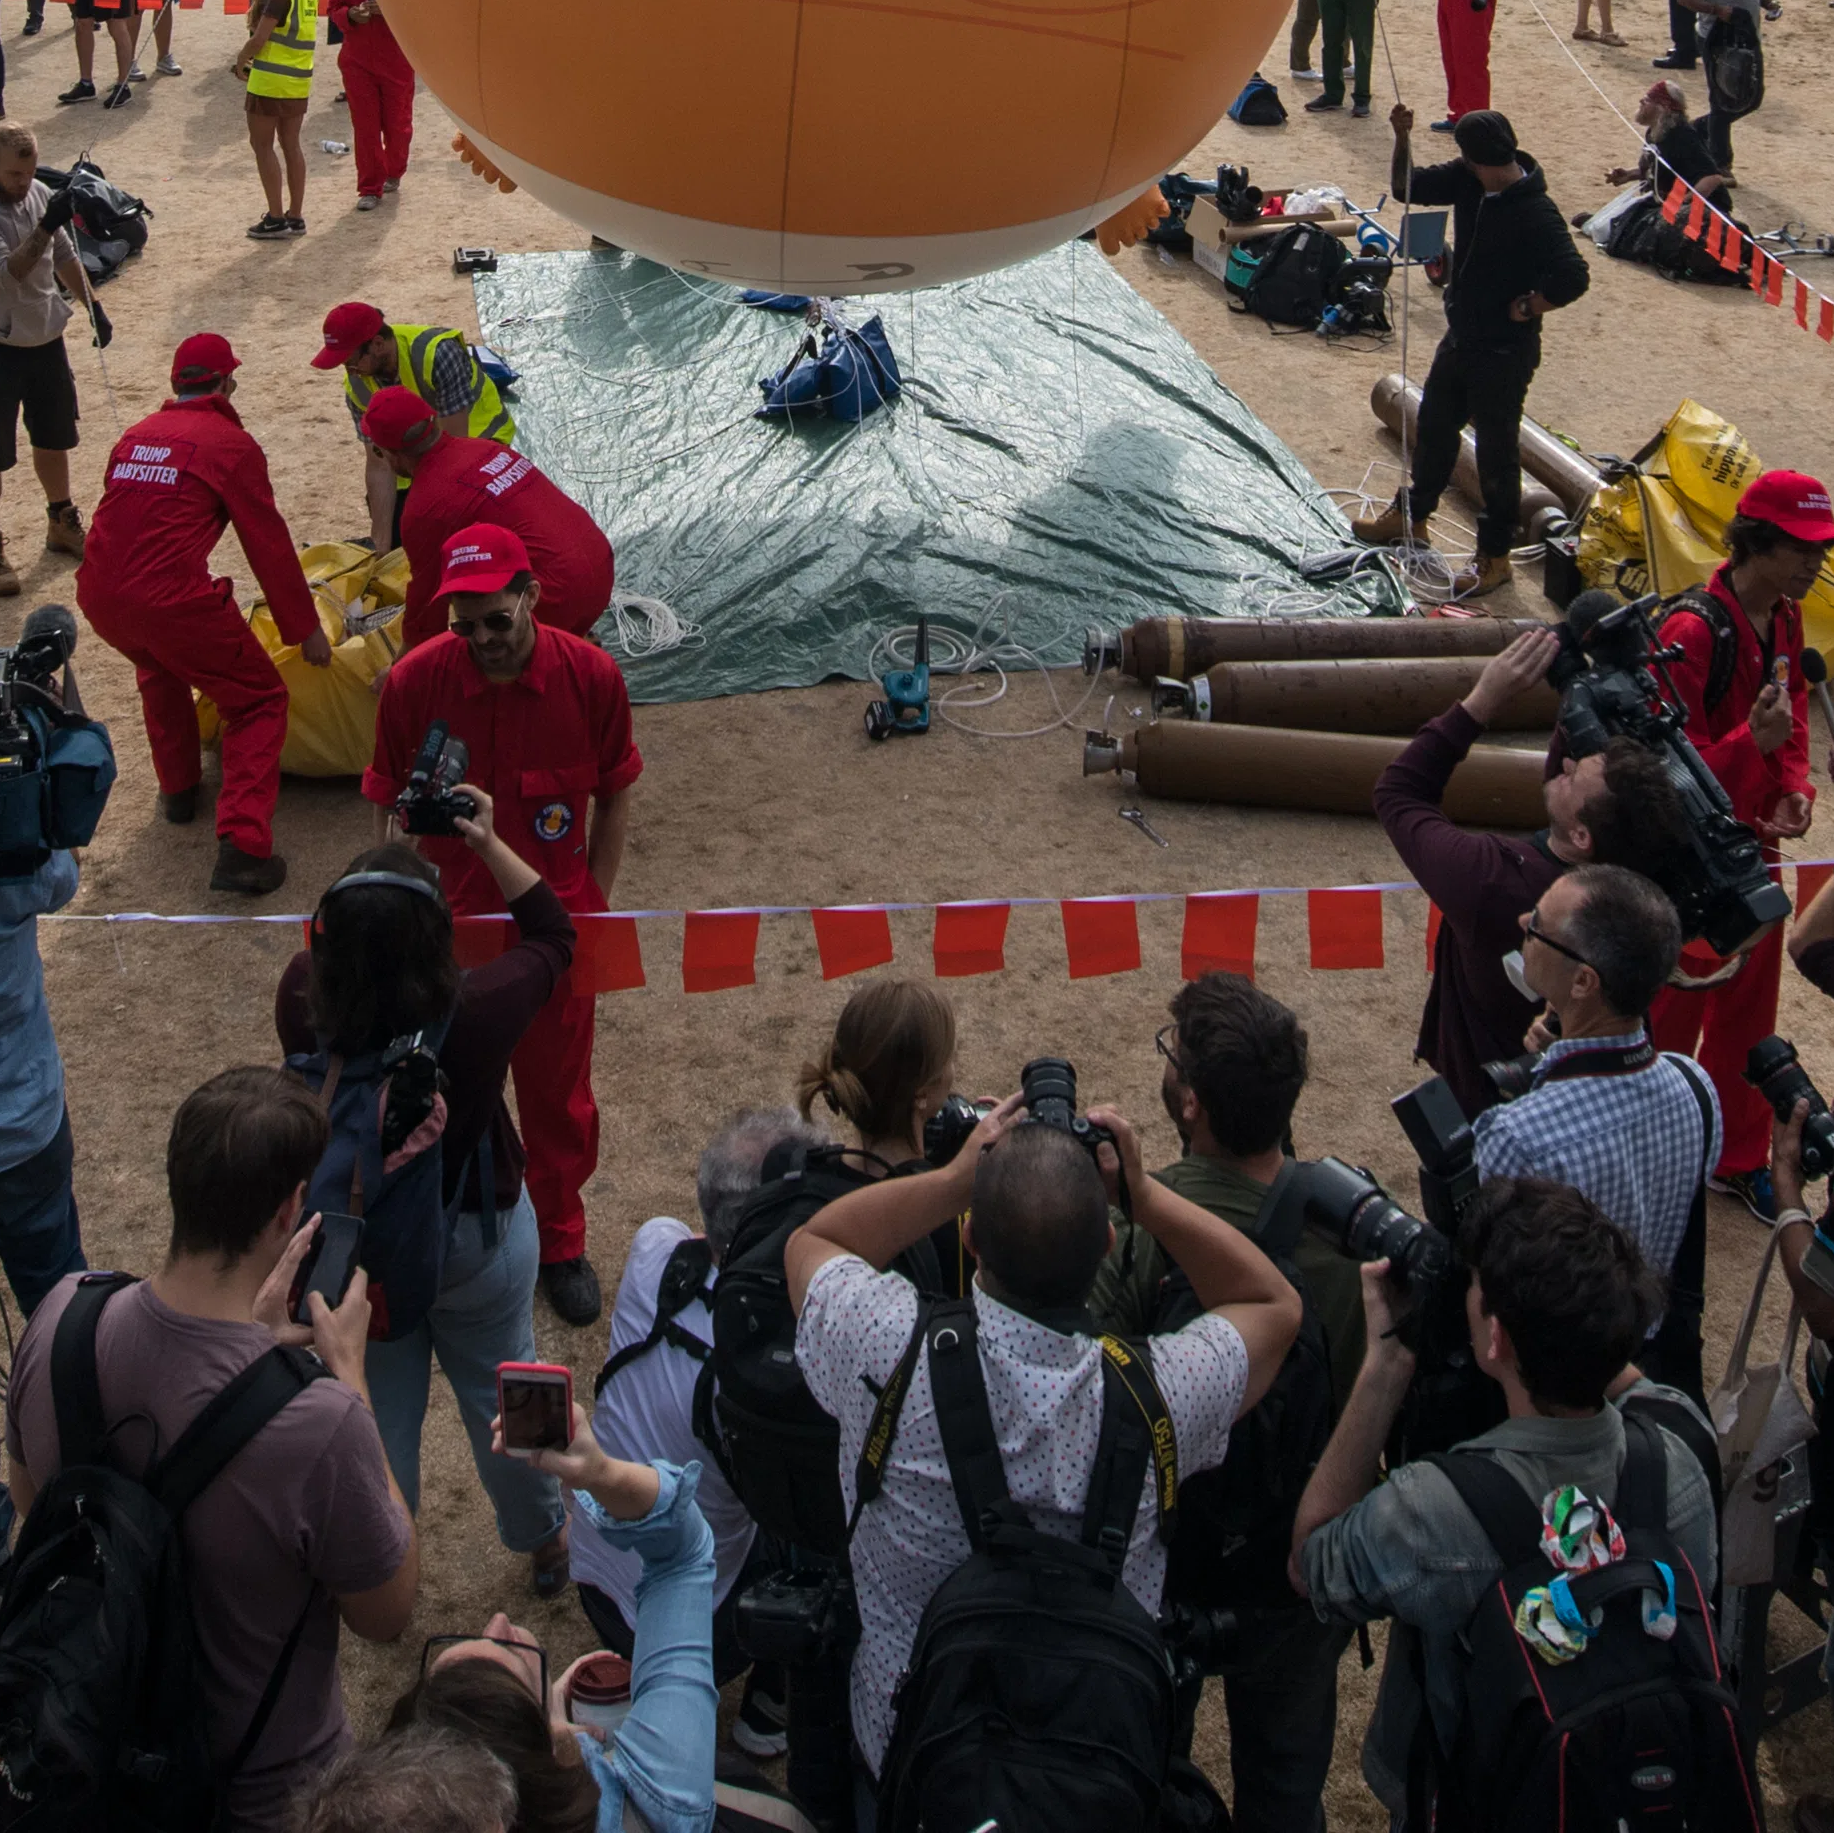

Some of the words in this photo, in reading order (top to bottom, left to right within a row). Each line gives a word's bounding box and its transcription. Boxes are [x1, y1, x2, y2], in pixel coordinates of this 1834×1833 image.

[130, 444, 172, 464] TRUMP
[479, 451, 514, 476] TRUMP
[1701, 457, 1714, 471] For
[112, 463, 179, 487] BABYSITTER
[451, 545, 480, 558] TRUMP
[866, 1413, 892, 1469] Nikon
[1154, 1416, 1176, 1466] D750
[1160, 1464, 1175, 1511] Nikon
